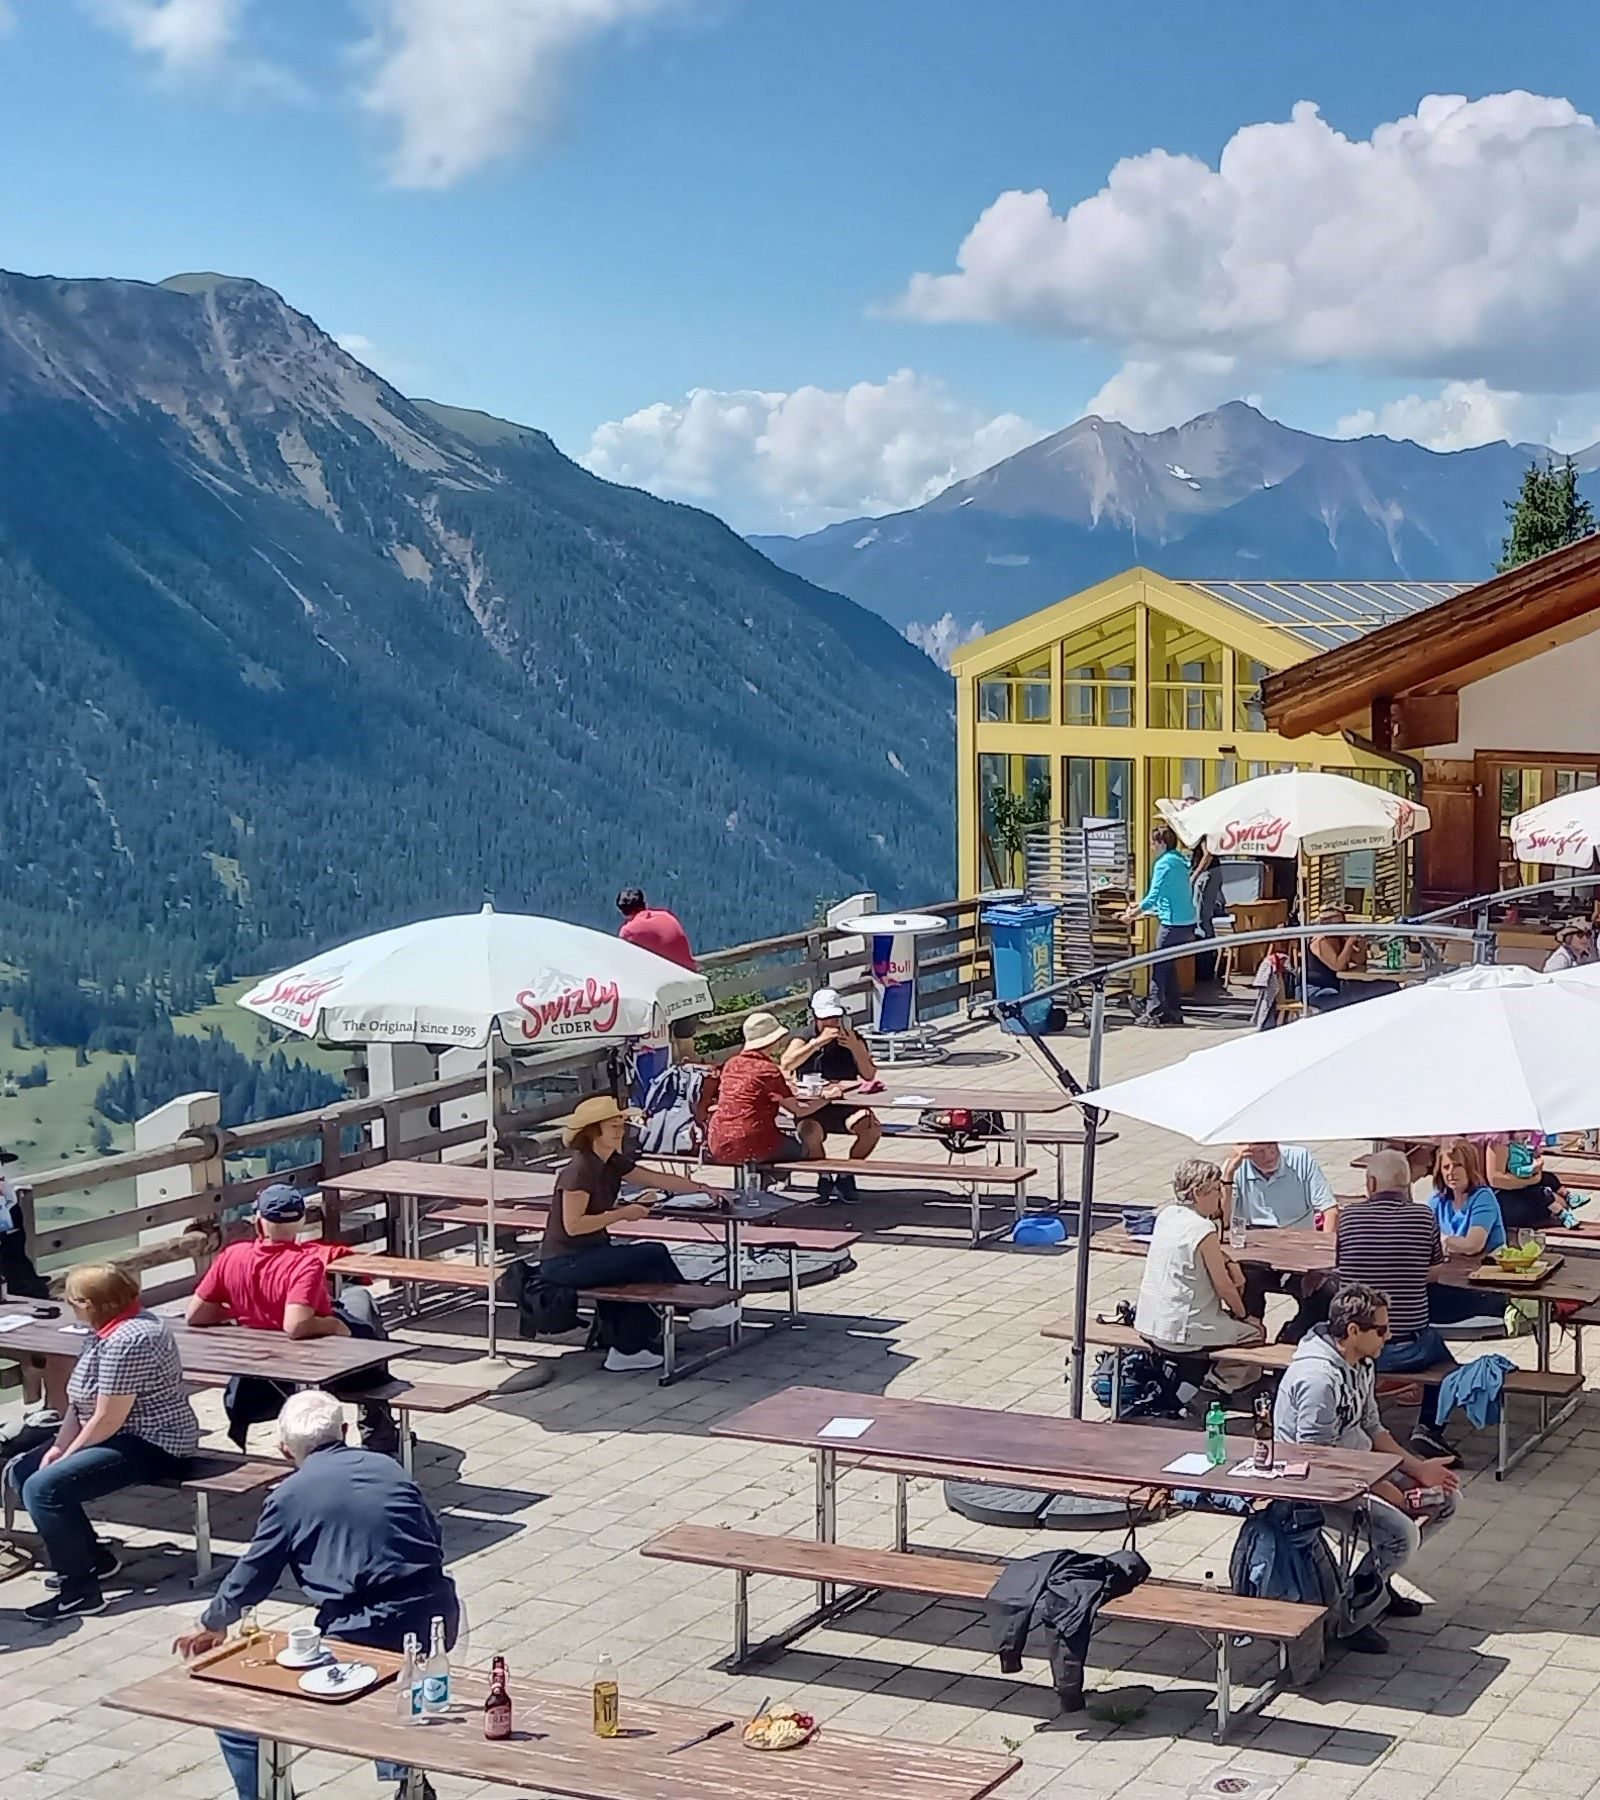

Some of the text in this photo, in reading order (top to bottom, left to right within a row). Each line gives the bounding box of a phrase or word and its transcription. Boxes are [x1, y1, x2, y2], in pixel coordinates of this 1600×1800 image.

[1219, 817, 1291, 853] Swizly
[516, 977, 619, 1039] Swizly
[343, 1019, 477, 1037] The Original since 1995
[551, 1021, 593, 1036] CIDER
